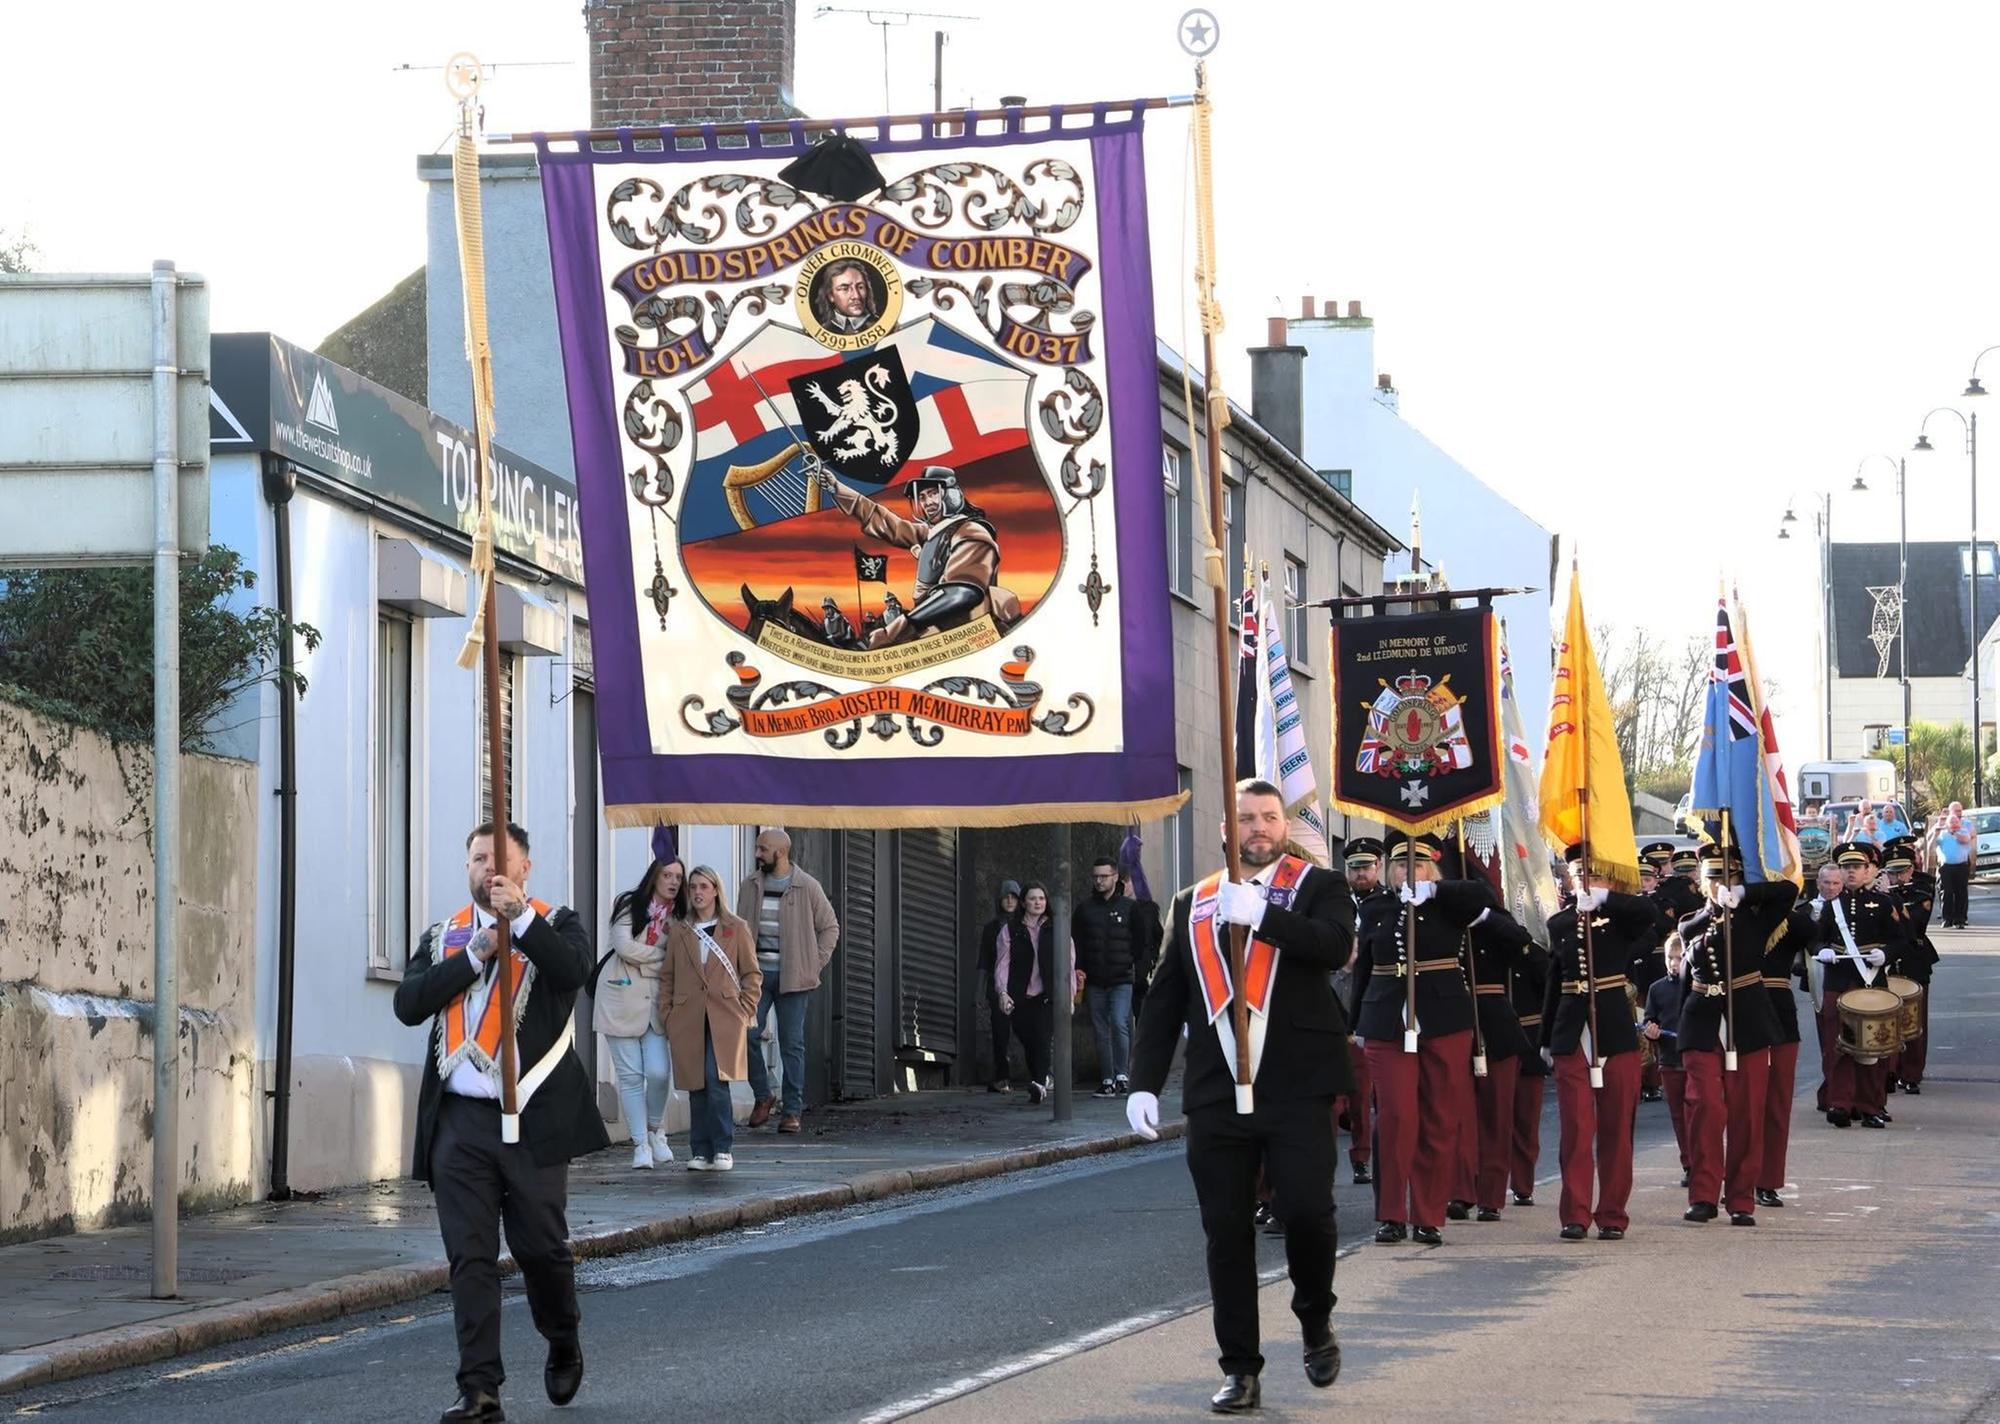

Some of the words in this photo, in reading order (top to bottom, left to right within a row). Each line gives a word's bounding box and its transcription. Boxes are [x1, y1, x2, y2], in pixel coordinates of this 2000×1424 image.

[632, 207, 869, 292] GOLDSPRINGS
[877, 222, 919, 257] OF
[930, 239, 1072, 280] COMBER
[796, 252, 828, 298] OLIVER
[830, 243, 899, 290] CROMWELL
[813, 324, 886, 350] 1599-1658
[1005, 324, 1080, 364] 1037
[274, 420, 373, 479] www.thewetsuitshop.co.uk
[795, 637, 831, 657] RIGHTEOUS
[872, 654, 882, 663] OF
[920, 639, 943, 652] THESE
[942, 621, 987, 645] BARBAROUS
[893, 662, 903, 673] SO
[903, 658, 922, 671] MUCH
[921, 650, 951, 667] INNOCENT
[1356, 652, 1371, 662] 2nd
[1381, 648, 1417, 660] EDMUND
[1420, 647, 1432, 657] DE
[1433, 645, 1457, 656] WIND
[1379, 639, 1388, 649] IN
[1389, 637, 1429, 648] MEMORY
[1433, 635, 1447, 646] OF
[752, 713, 764, 733] IN
[838, 690, 900, 719] JOSEPH
